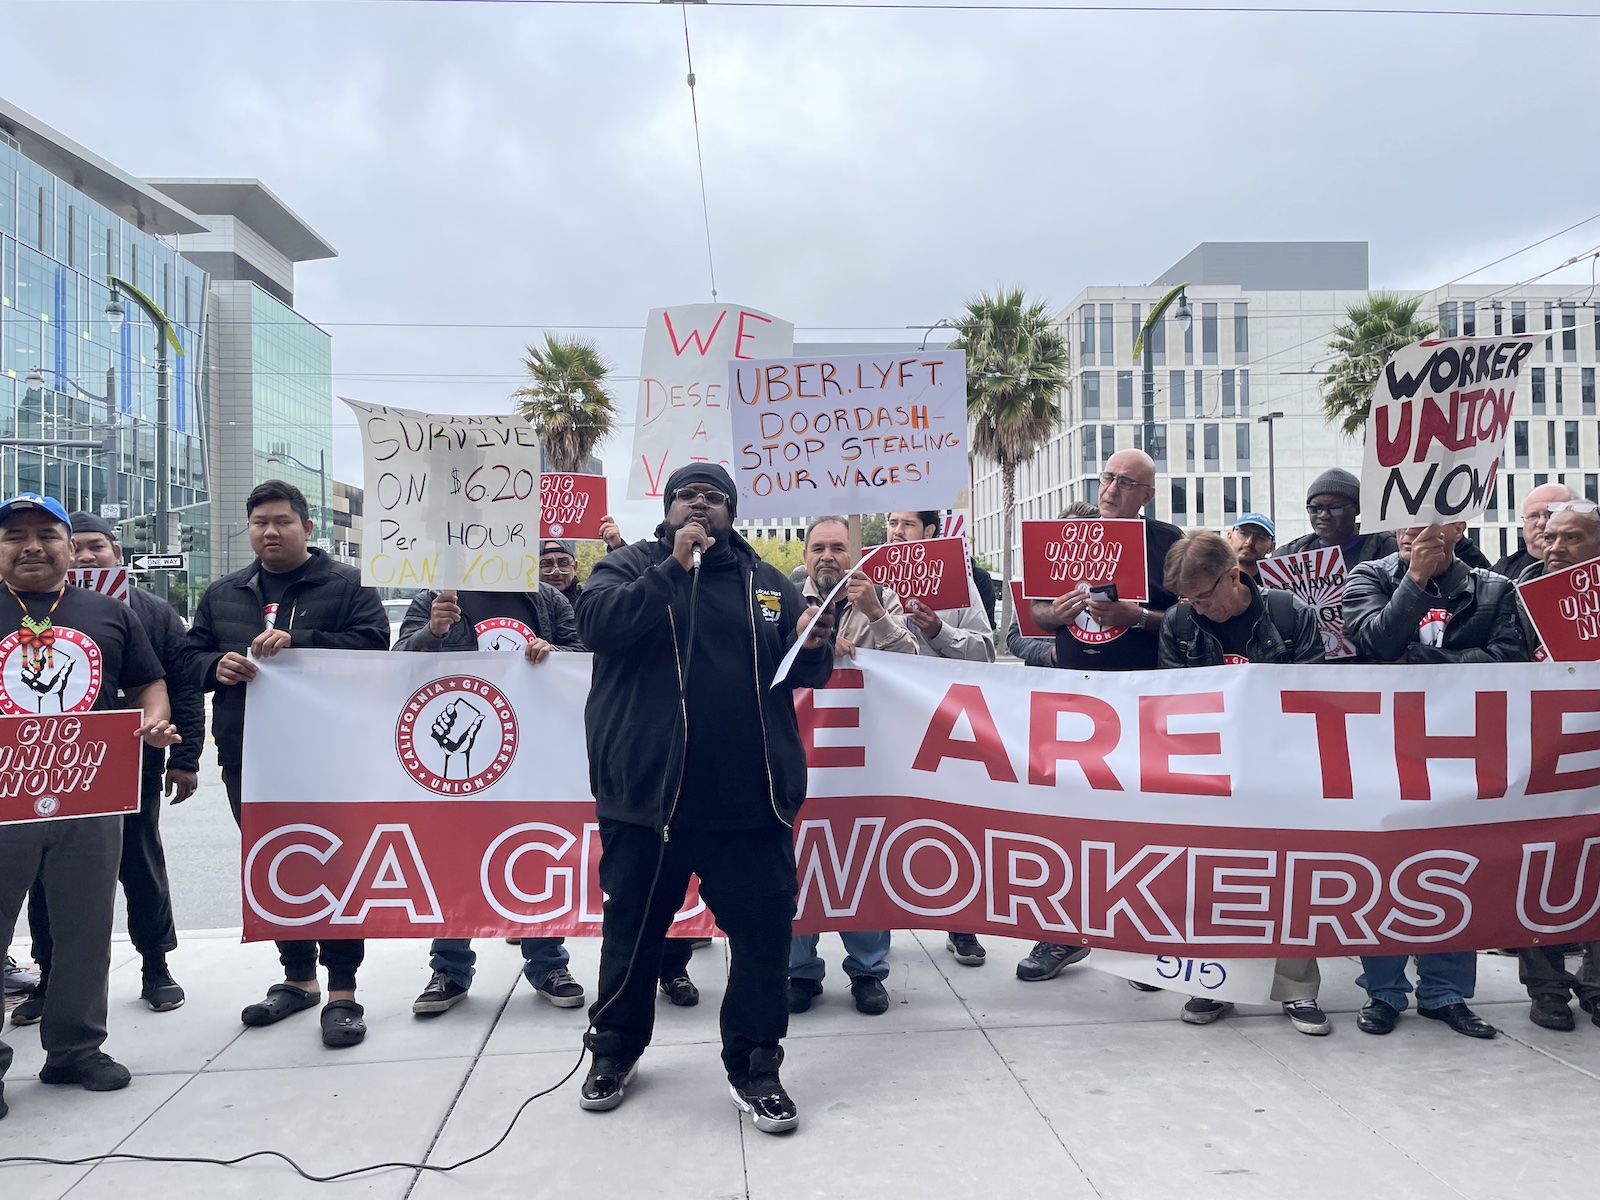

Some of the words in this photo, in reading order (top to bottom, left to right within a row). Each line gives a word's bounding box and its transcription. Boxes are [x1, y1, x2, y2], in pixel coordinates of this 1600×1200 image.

[663, 310, 772, 360] WE
[1385, 342, 1533, 400] WORKER
[643, 378, 731, 427] DESE
[367, 417, 536, 461] SURVIVE
[692, 420, 707, 441] A
[1375, 387, 1515, 468] UNION
[741, 438, 825, 470] STOP
[841, 432, 961, 460] STEALING
[377, 472, 426, 510] ON
[450, 465, 533, 502] $6.20
[540, 475, 574, 492] GIG
[752, 469, 818, 496] OUR
[827, 461, 930, 488] WAGES!
[540, 491, 589, 508] NION
[380, 519, 417, 553] Per
[447, 521, 526, 550] HOUR
[1061, 522, 1104, 543] GIG
[886, 543, 926, 565] GIG
[1045, 541, 1122, 562] UNION
[370, 553, 439, 584] CAN
[458, 554, 537, 588] YOU?
[873, 559, 944, 584] UNION
[1050, 560, 1117, 581] NOW!
[1287, 560, 1315, 576] WE
[1570, 563, 1600, 592] GI
[499, 619, 519, 629] GIG
[1076, 630, 1111, 641] UNION
[80, 637, 100, 703] WORKERS
[16, 717, 81, 745] GIG
[400, 683, 444, 770] CALIFORNIA
[462, 680, 490, 696] GIG
[492, 696, 514, 772] WORKERS
[792, 668, 865, 768] E
[911, 683, 1232, 796] ARE
[1280, 690, 1600, 800] THE
[0, 766, 98, 797] NOW!
[430, 778, 485, 793] UNION
[244, 823, 445, 926] CA
[791, 817, 1480, 946] WORKERS
